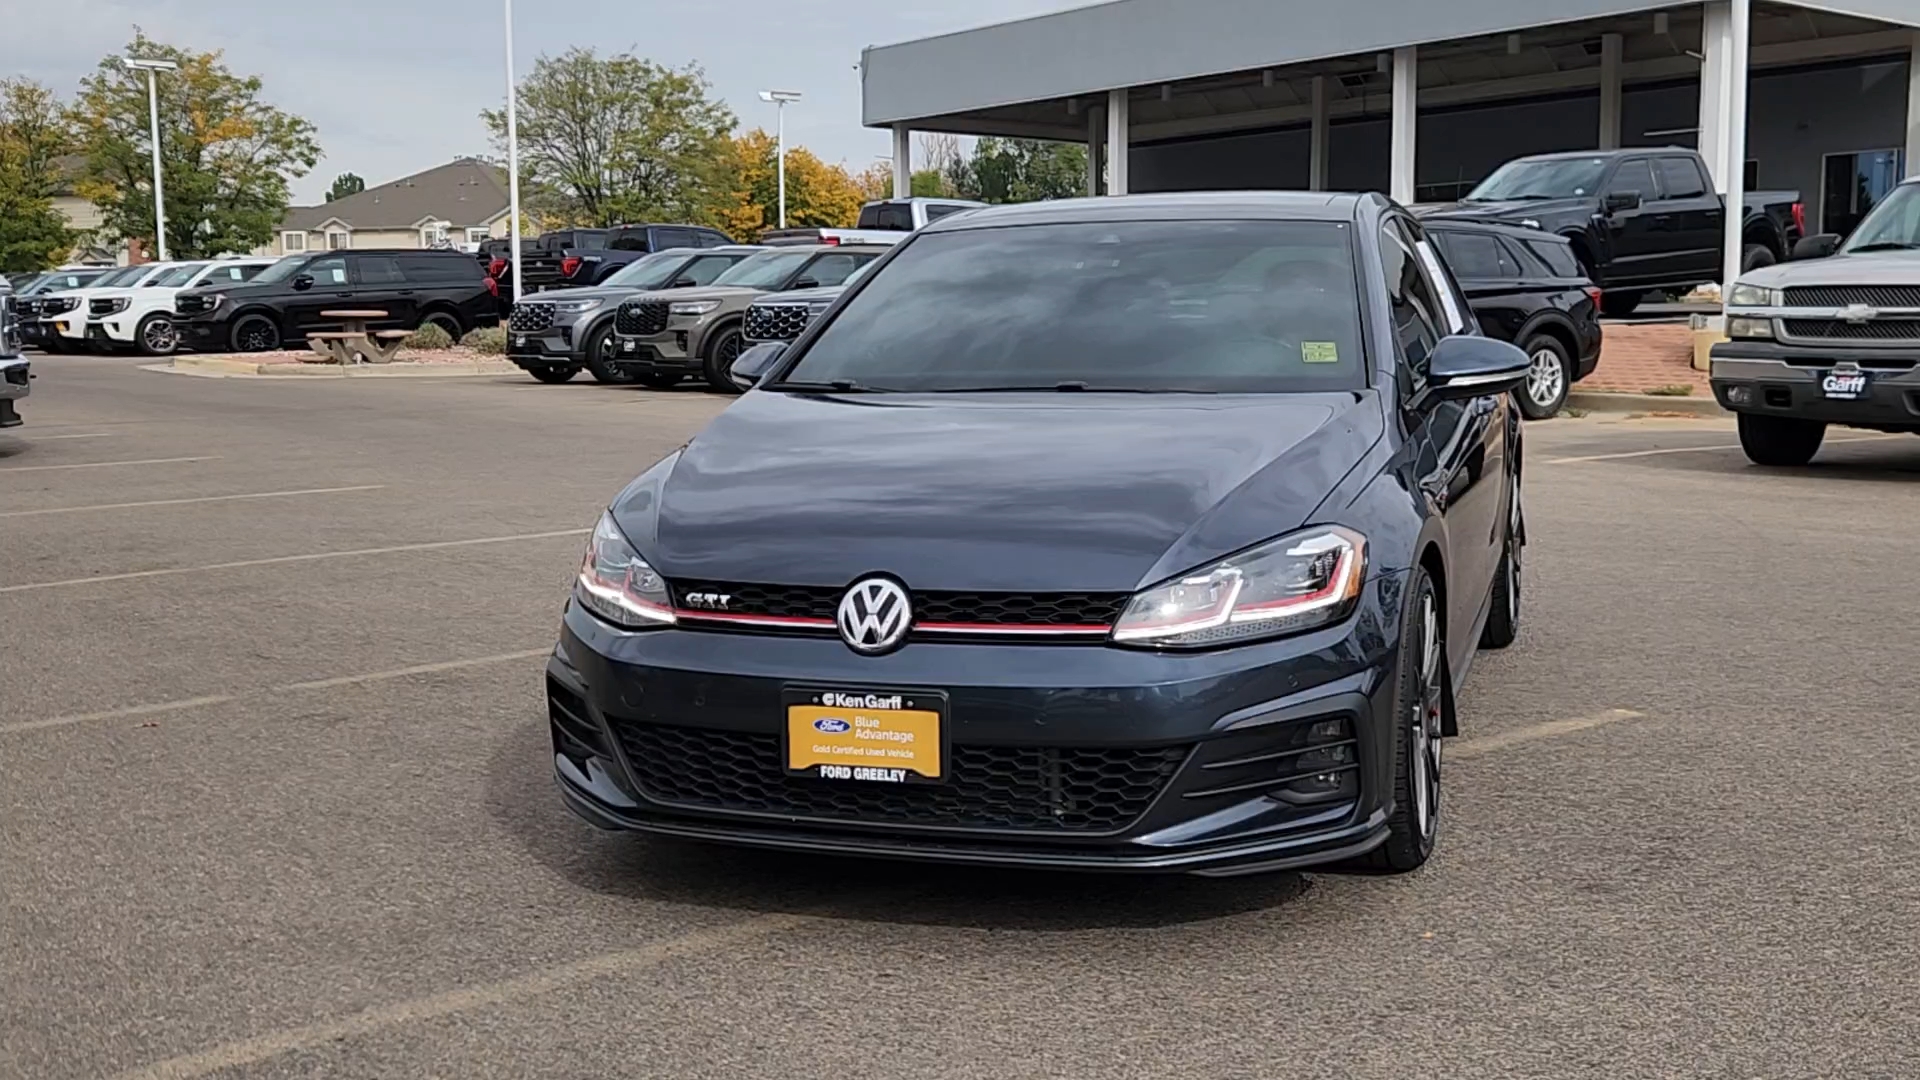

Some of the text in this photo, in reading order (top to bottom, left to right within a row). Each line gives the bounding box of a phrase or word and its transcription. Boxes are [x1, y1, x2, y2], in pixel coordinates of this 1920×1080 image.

[1823, 376, 1866, 392] Garff
[685, 591, 731, 609] GTI
[835, 693, 902, 709] Ken Garff
[820, 719, 844, 732] Ford
[855, 716, 880, 728] Blue
[855, 729, 914, 743] Advantage
[812, 745, 915, 758] Gold Certified Used Vehicle
[820, 765, 905, 782] FORD GREELEY
